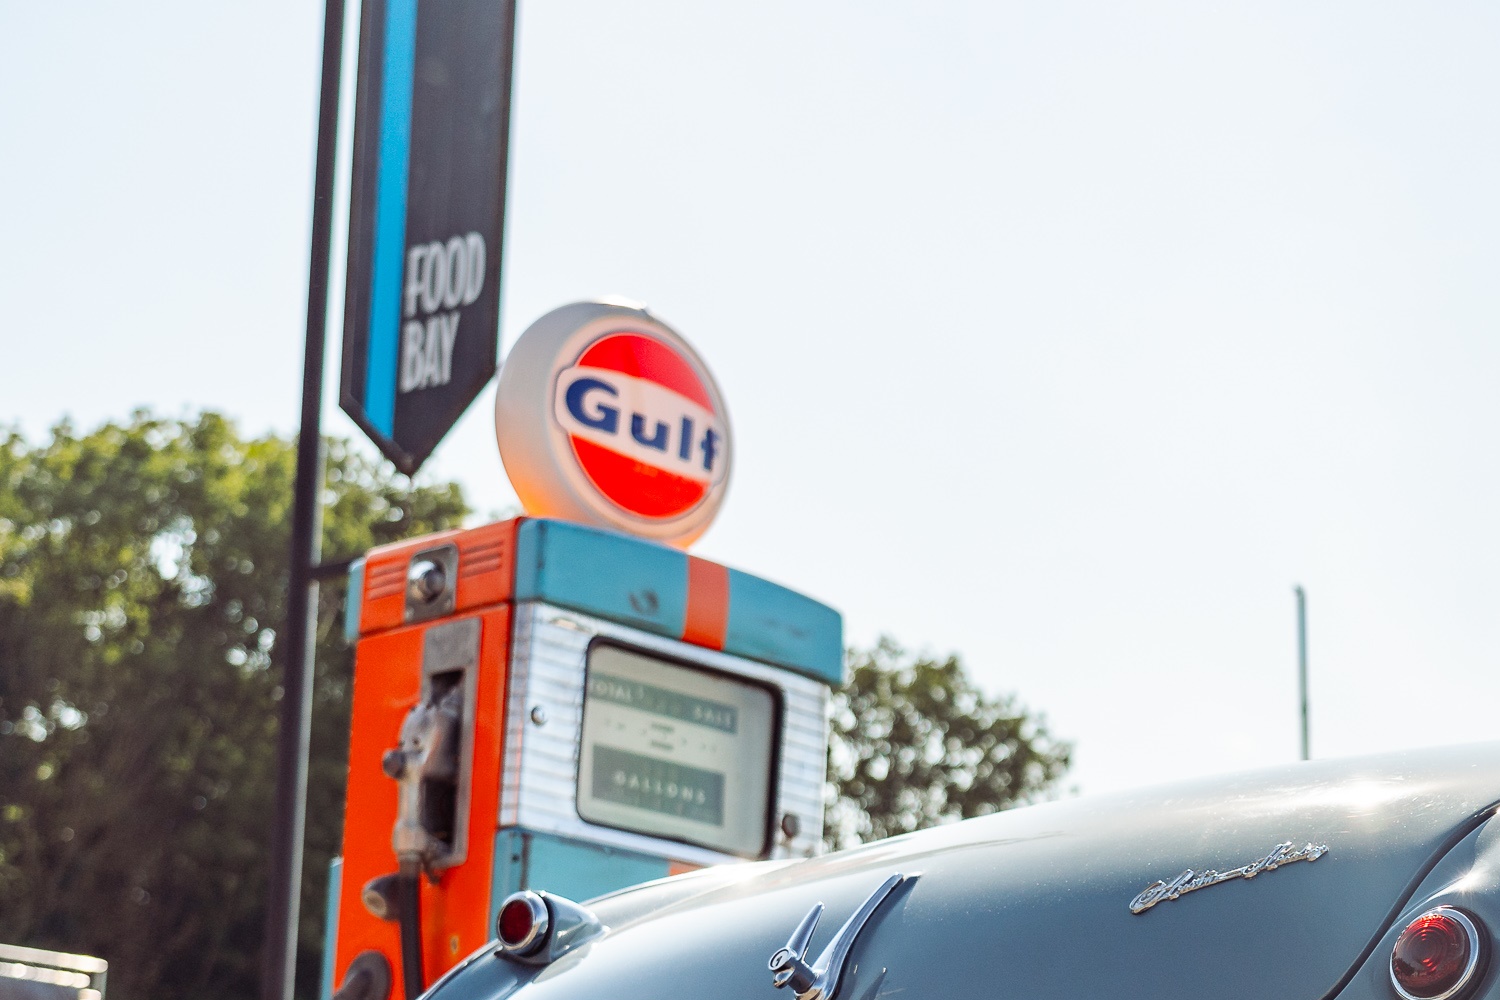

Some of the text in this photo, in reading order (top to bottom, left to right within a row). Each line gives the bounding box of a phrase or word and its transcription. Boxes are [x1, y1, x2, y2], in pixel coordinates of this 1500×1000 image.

[405, 231, 487, 317] FOOD
[401, 312, 460, 393] BAY
[565, 376, 723, 473] Gulf
[612, 770, 706, 806] GALLONS
